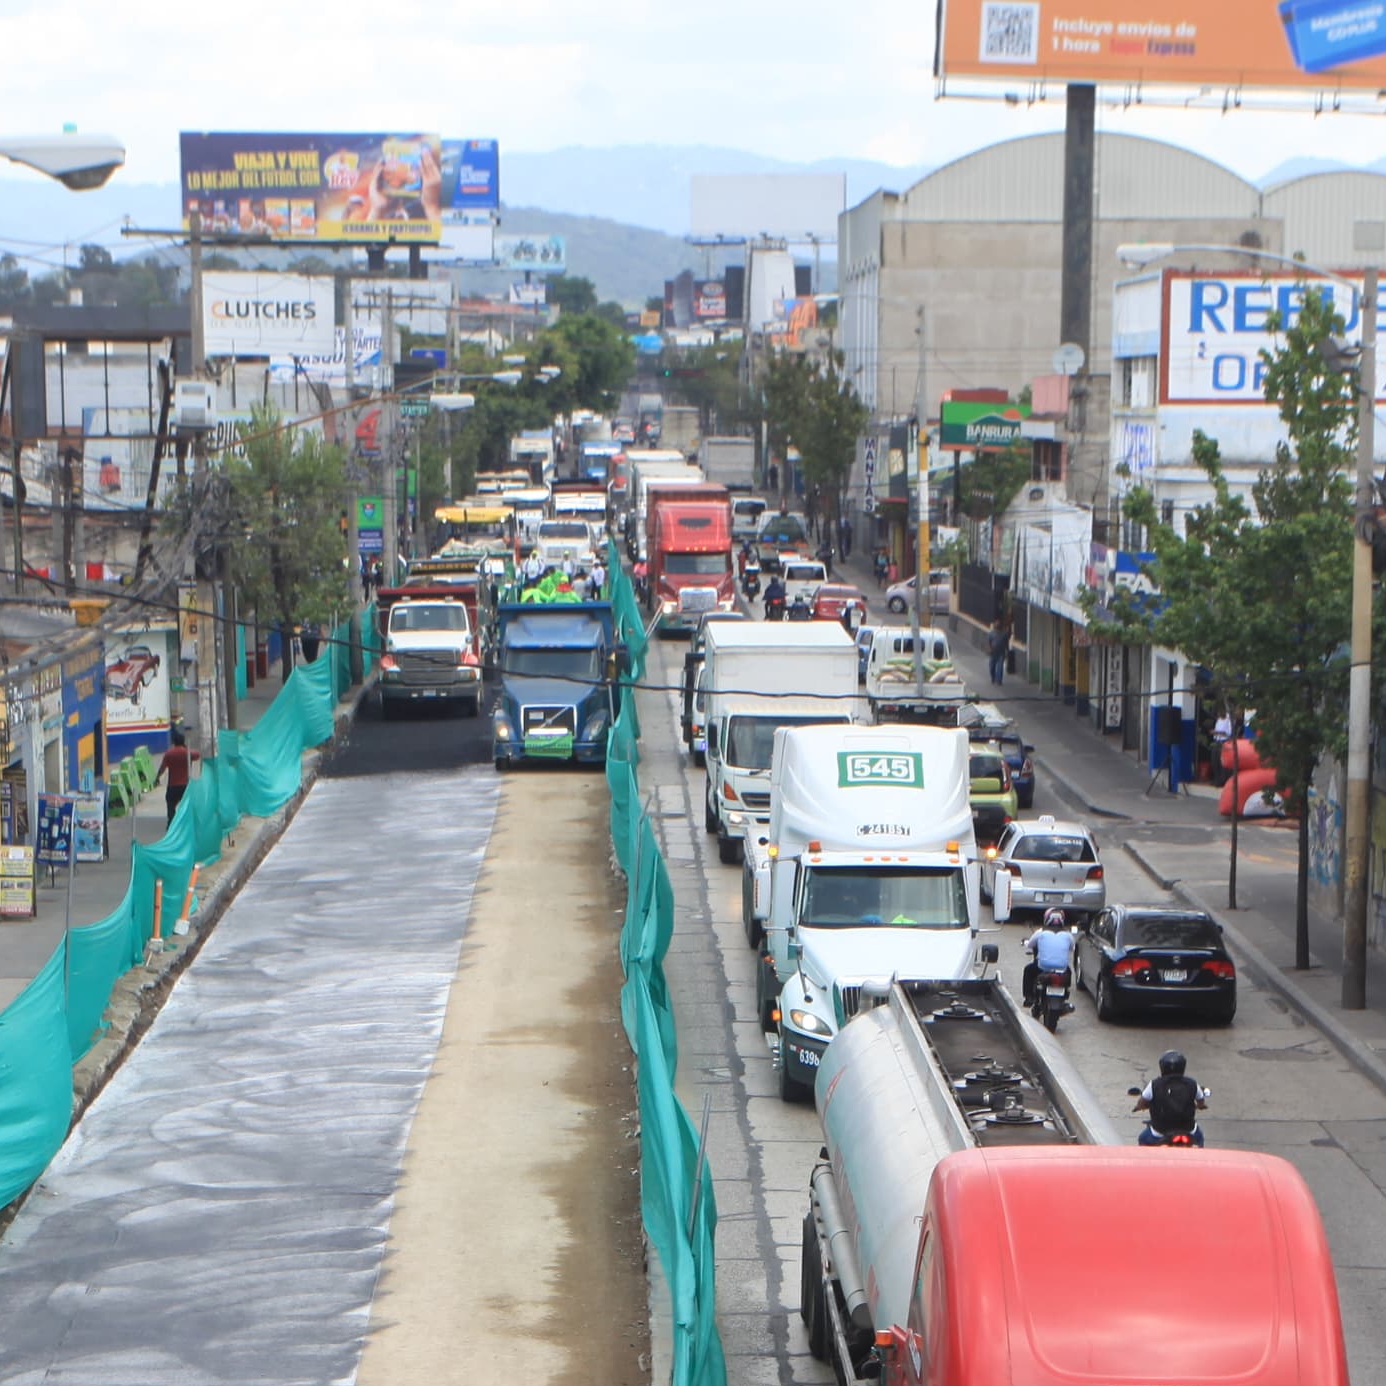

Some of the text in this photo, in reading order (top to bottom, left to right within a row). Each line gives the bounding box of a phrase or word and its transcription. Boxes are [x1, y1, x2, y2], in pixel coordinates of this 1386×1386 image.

[1053, 17, 1113, 35] Incluye
[1176, 22, 1196, 36] de
[1063, 37, 1101, 52] hora
[234, 151, 319, 169] VIAJA Y VIVE
[188, 172, 201, 190] LO
[202, 171, 239, 189] MEJOR
[242, 170, 261, 187] DEL
[299, 168, 320, 186] CON
[211, 300, 317, 319] CLUTCHES
[966, 422, 1021, 438] BANRURA
[865, 438, 876, 511] MANTAS
[854, 758, 910, 778] 545
